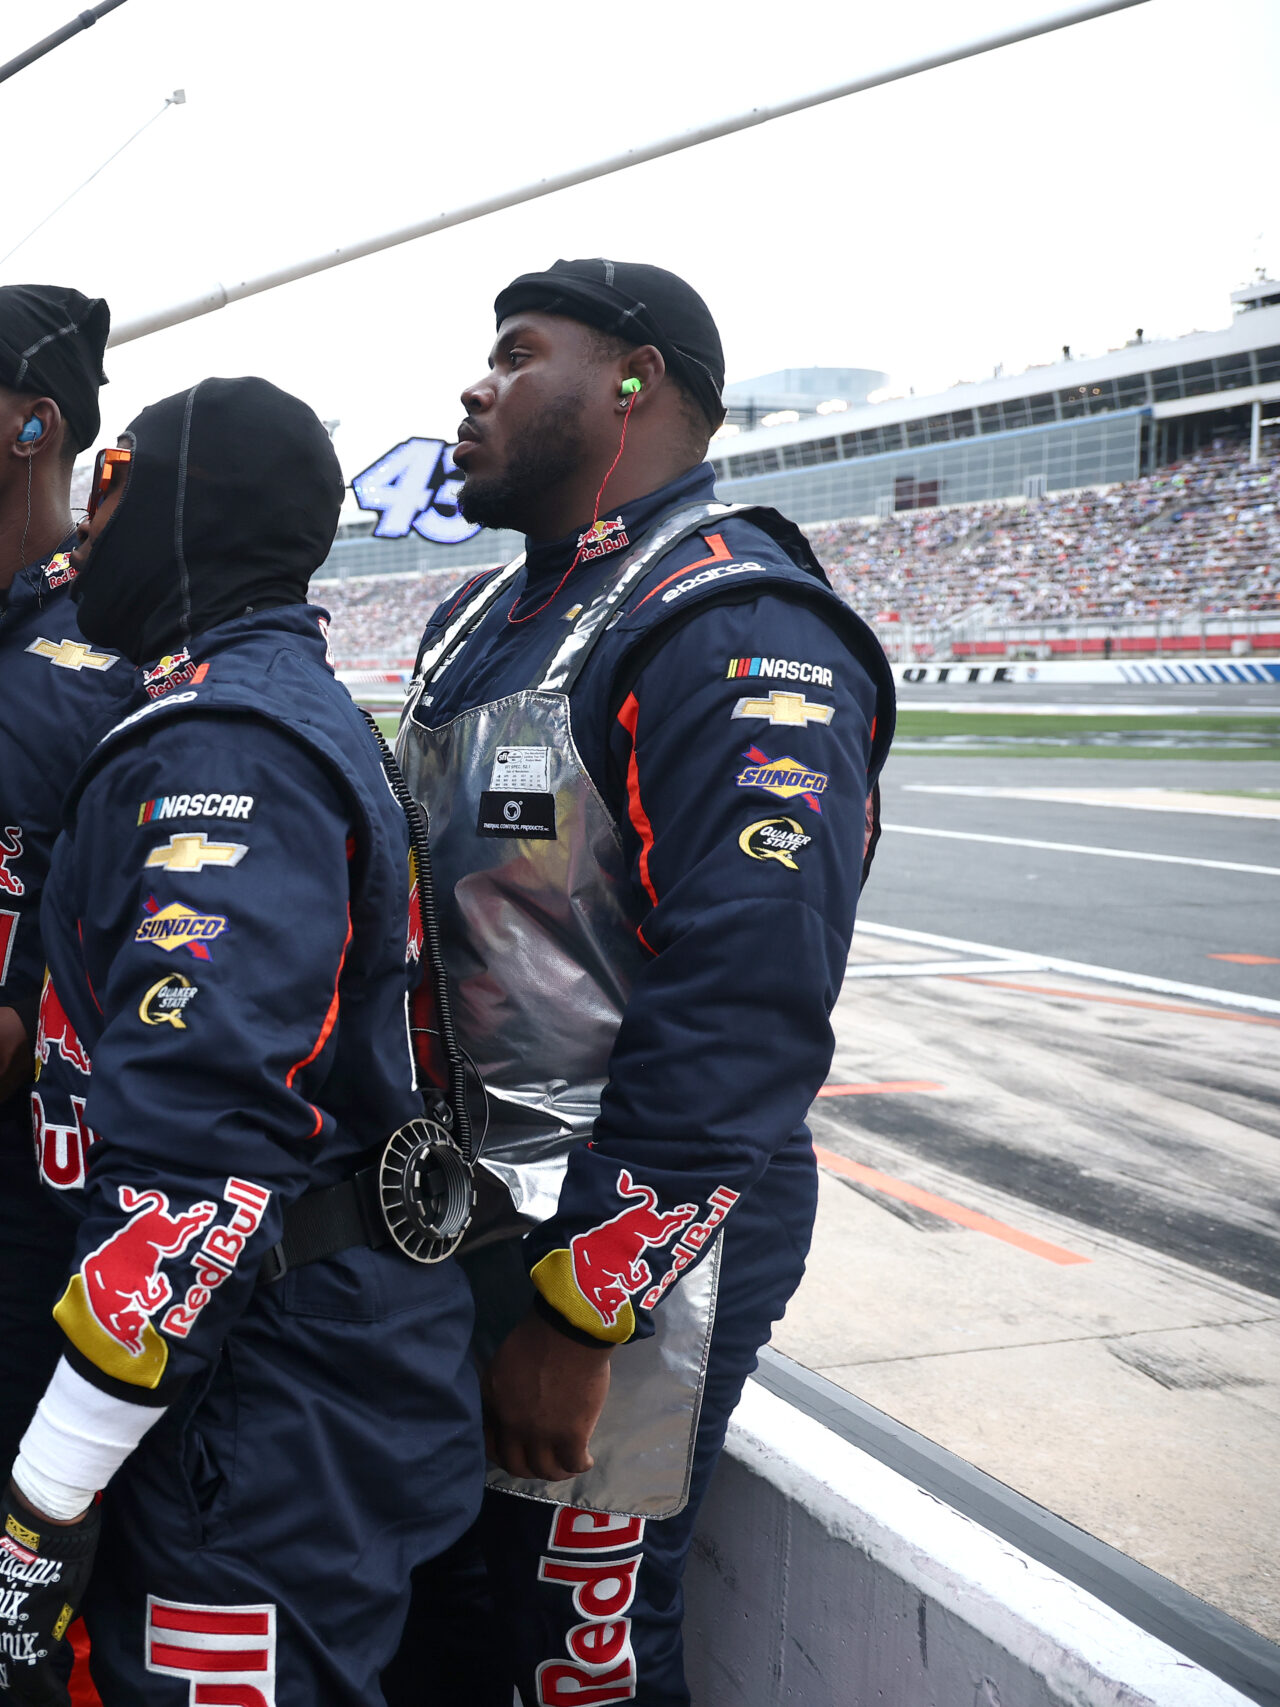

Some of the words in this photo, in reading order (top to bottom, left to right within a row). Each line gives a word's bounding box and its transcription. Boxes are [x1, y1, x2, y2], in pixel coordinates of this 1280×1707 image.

[580, 546, 604, 562] Red
[601, 531, 630, 555] Bull
[146, 675, 175, 699] Red
[171, 661, 198, 685] Bull
[759, 657, 834, 687] NASCAR
[740, 768, 826, 792] SUNOCO
[159, 794, 254, 819] NASCAR
[759, 825, 812, 845] QUAKER
[763, 837, 800, 851] STATE
[138, 917, 223, 939] SUNOCO
[157, 985, 198, 999] QUAKER
[159, 998, 188, 1008] STATE
[159, 1251, 233, 1339] Red
[201, 1176, 272, 1267] Bull
[639, 1243, 698, 1311] Red
[680, 1185, 741, 1251] Bull
[535, 1552, 645, 1707] Red
